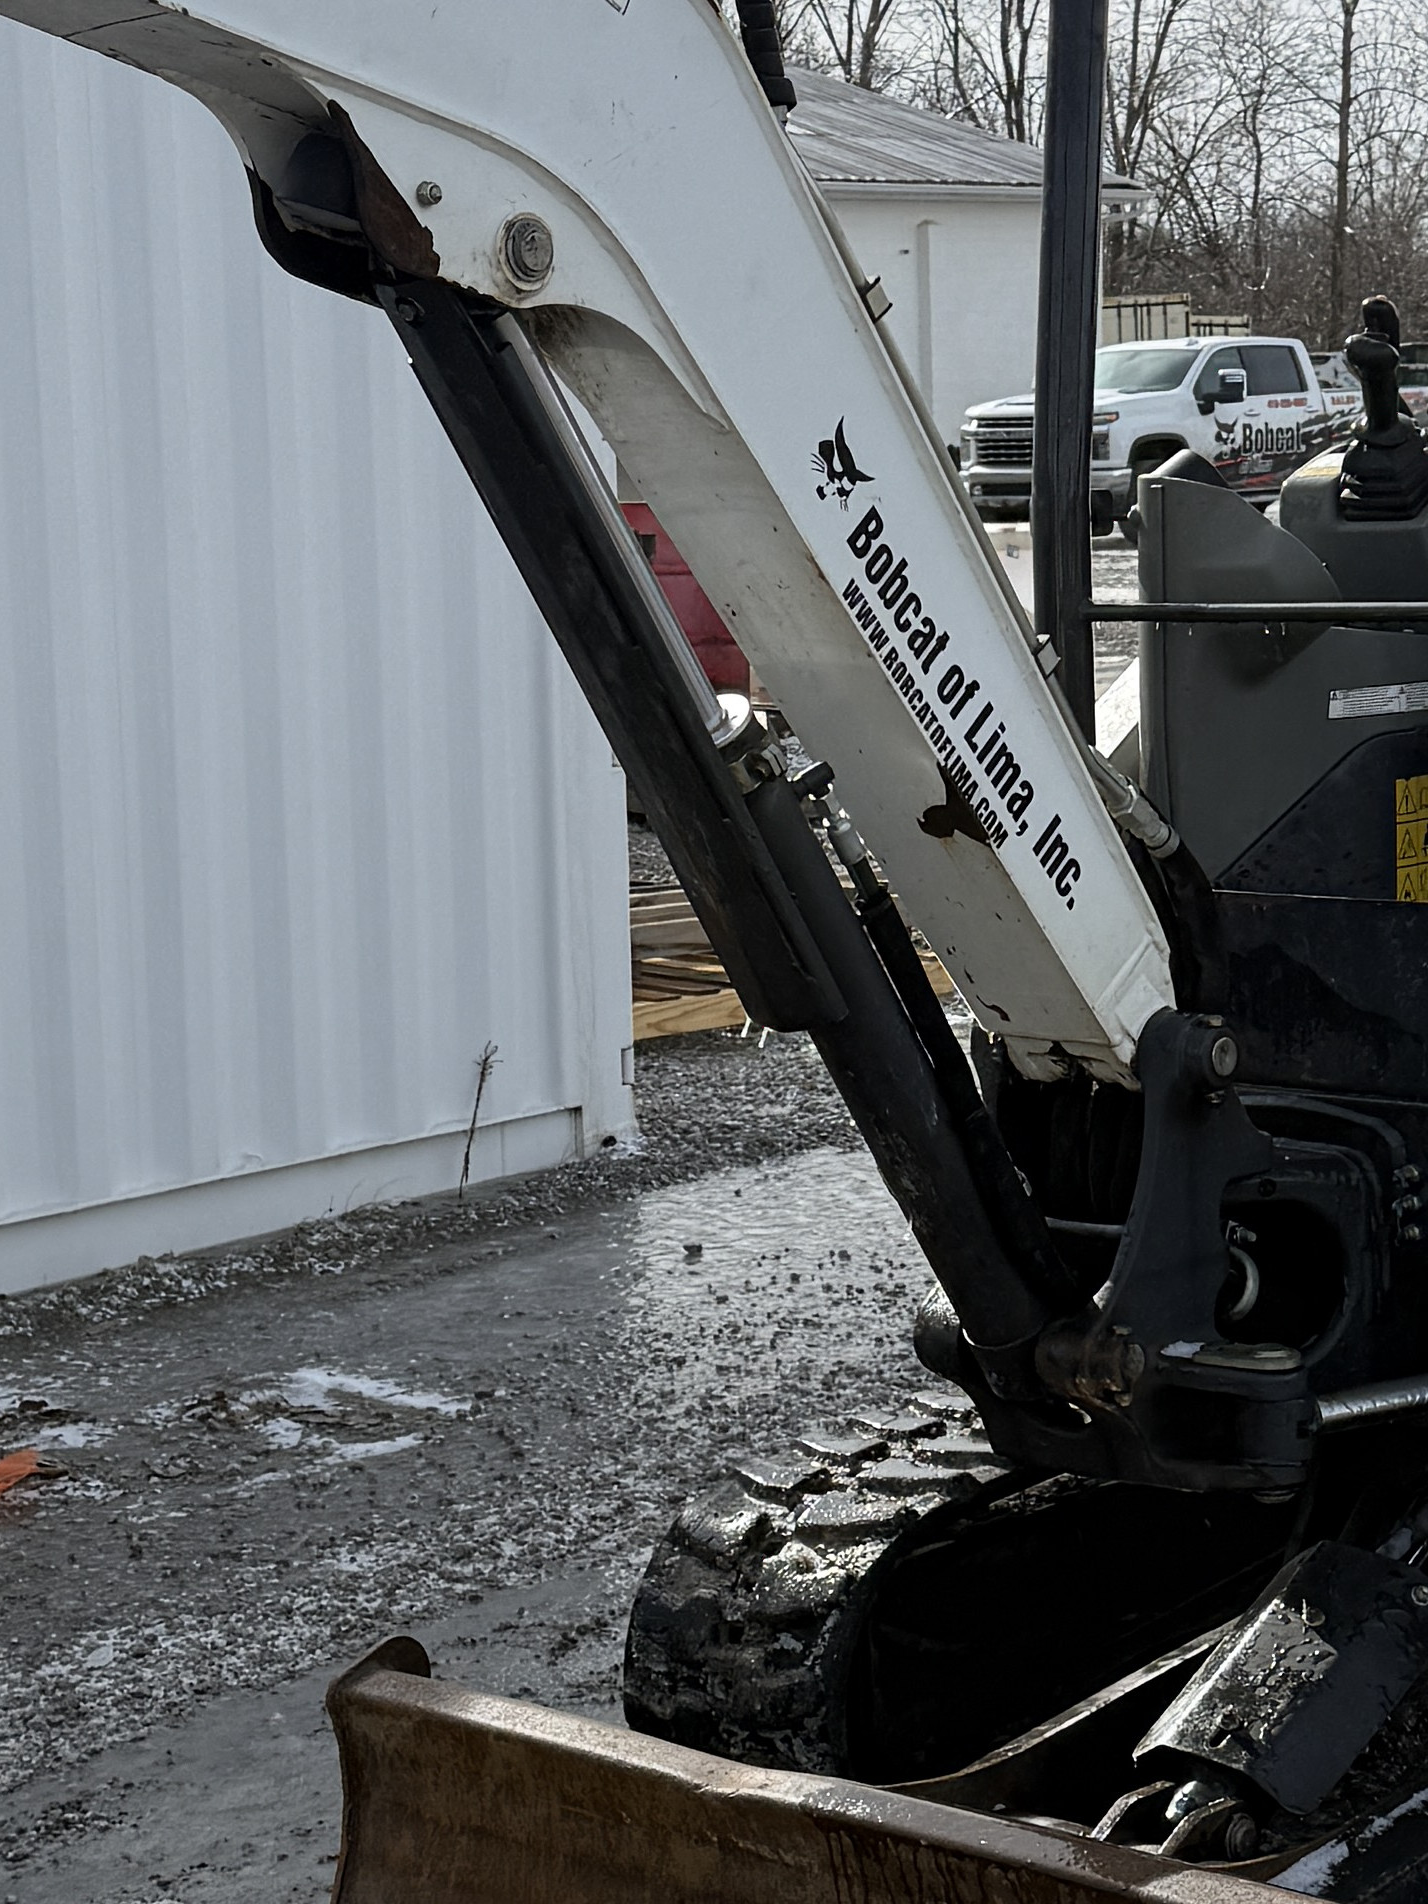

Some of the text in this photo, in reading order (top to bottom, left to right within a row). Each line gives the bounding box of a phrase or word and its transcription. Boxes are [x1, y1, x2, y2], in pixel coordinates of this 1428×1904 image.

[1242, 421, 1303, 454] Bobcat
[841, 577, 1010, 850] WWW.BOBCATOFLIMA.COM
[846, 505, 1082, 911] Bobcat of Lima, Inc.
